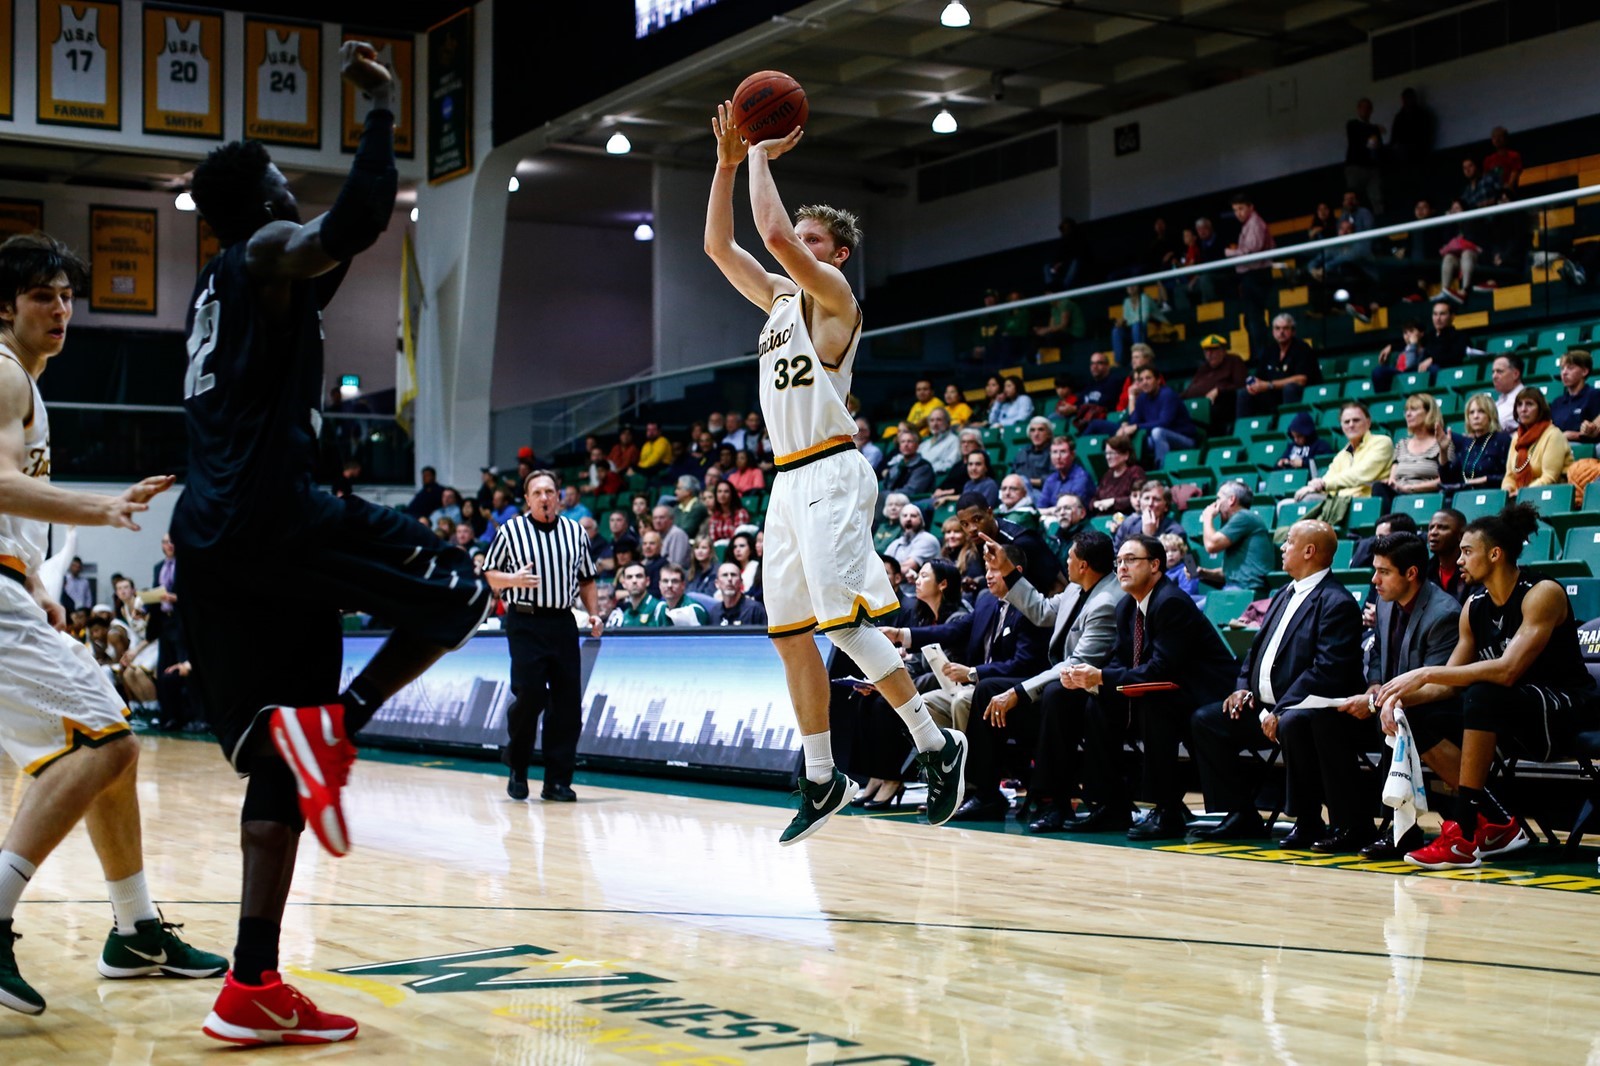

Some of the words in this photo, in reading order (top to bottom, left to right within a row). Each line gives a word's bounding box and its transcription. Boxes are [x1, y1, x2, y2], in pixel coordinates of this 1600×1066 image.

[63, 28, 95, 43] USF
[66, 49, 93, 72] 17
[170, 60, 198, 83] 20
[270, 71, 296, 94] 24
[54, 104, 104, 120] FARMER
[774, 354, 815, 390] 32
[574, 988, 863, 1052] WEST
